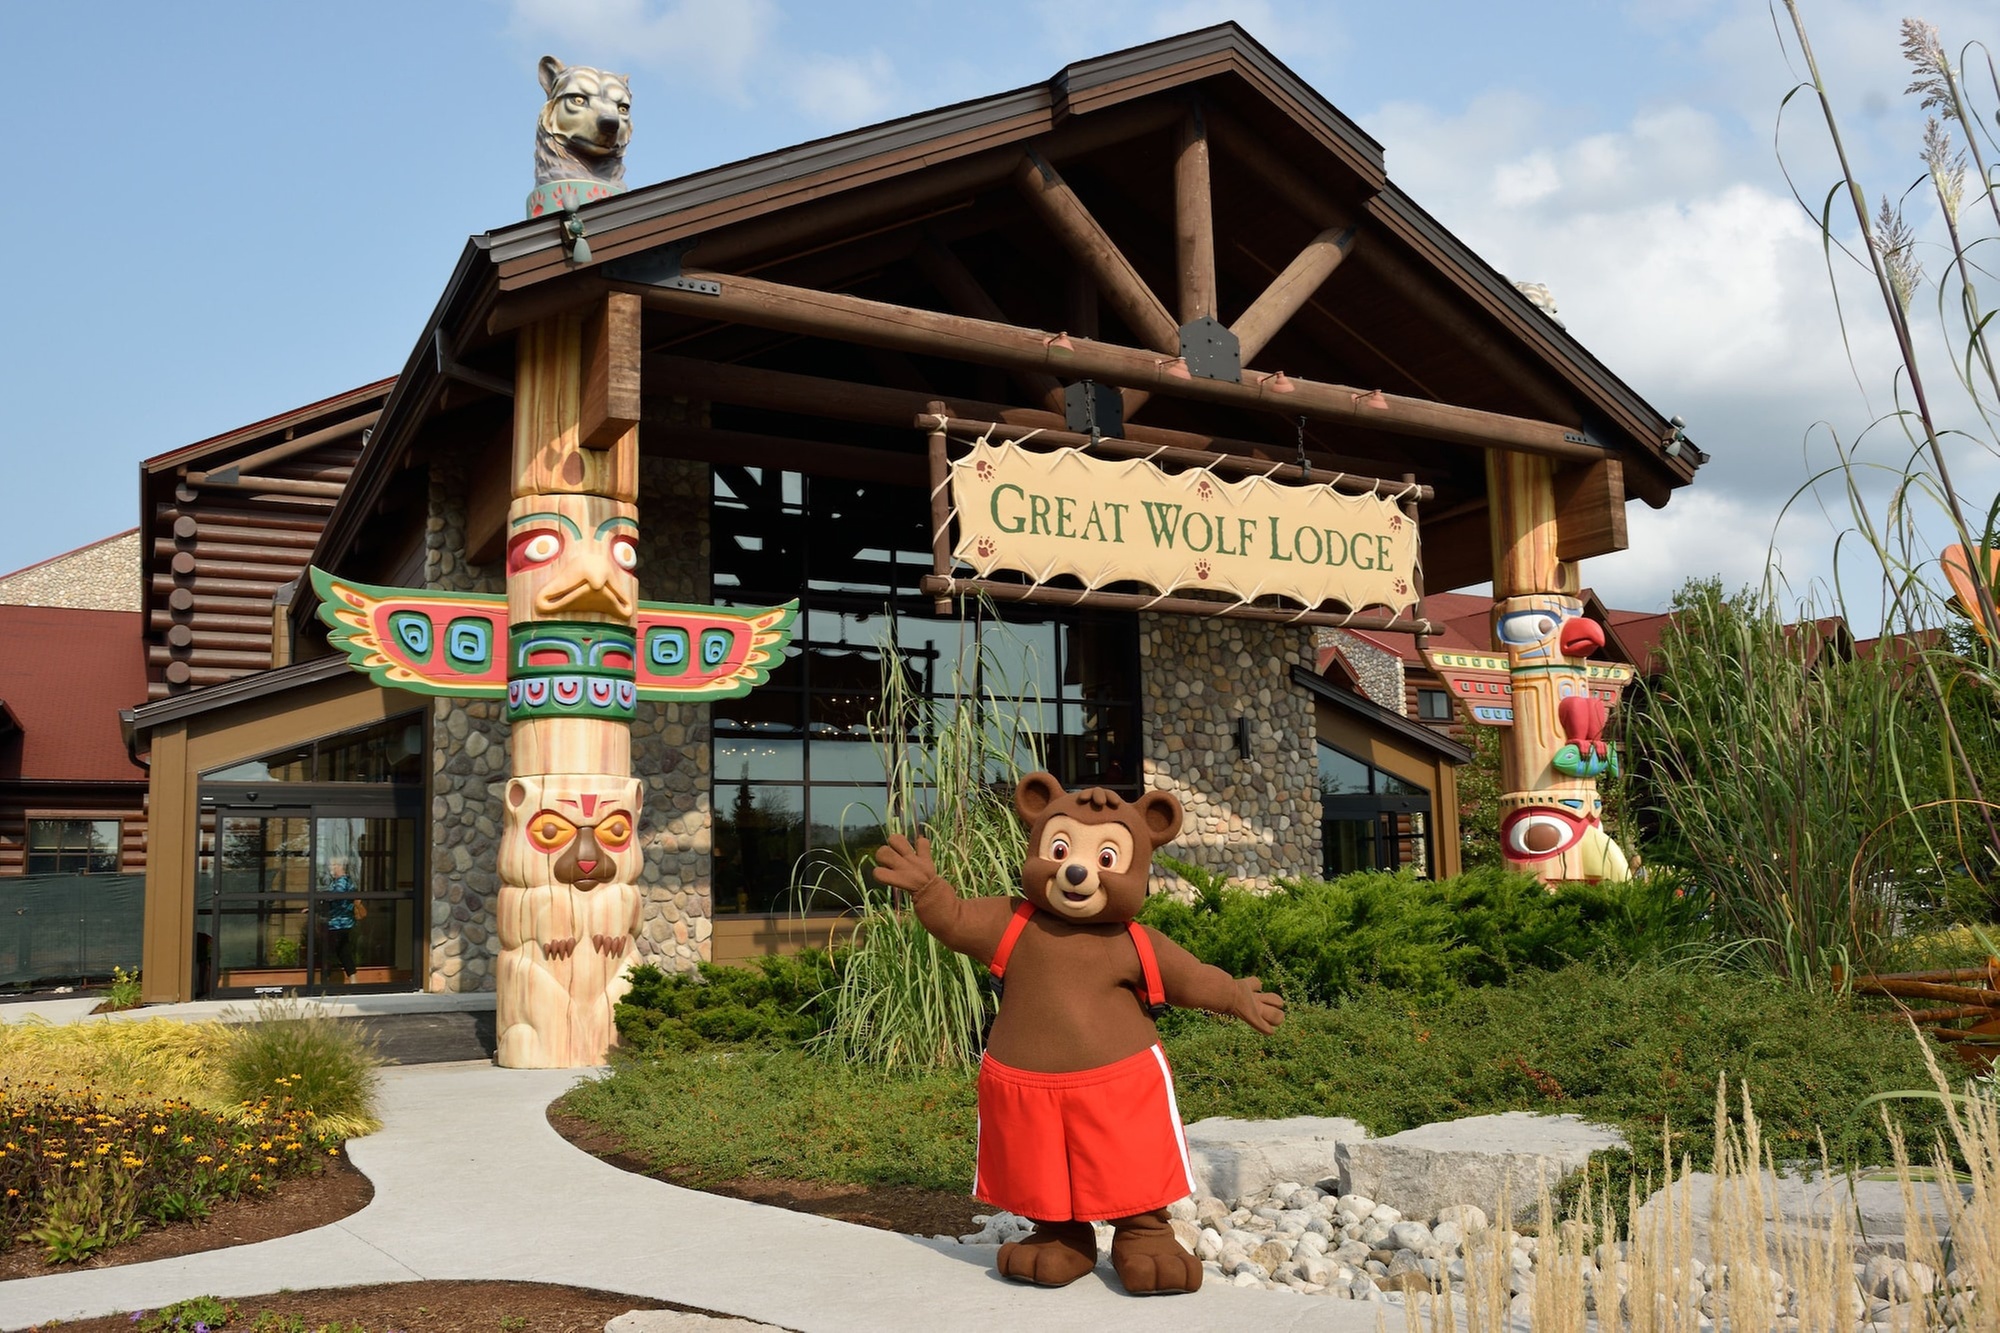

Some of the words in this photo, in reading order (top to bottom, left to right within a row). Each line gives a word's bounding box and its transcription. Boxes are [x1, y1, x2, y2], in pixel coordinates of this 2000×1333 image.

[990, 483, 1129, 544] GREAT
[1141, 501, 1257, 557] WOLF
[1268, 516, 1394, 572] LODGE
